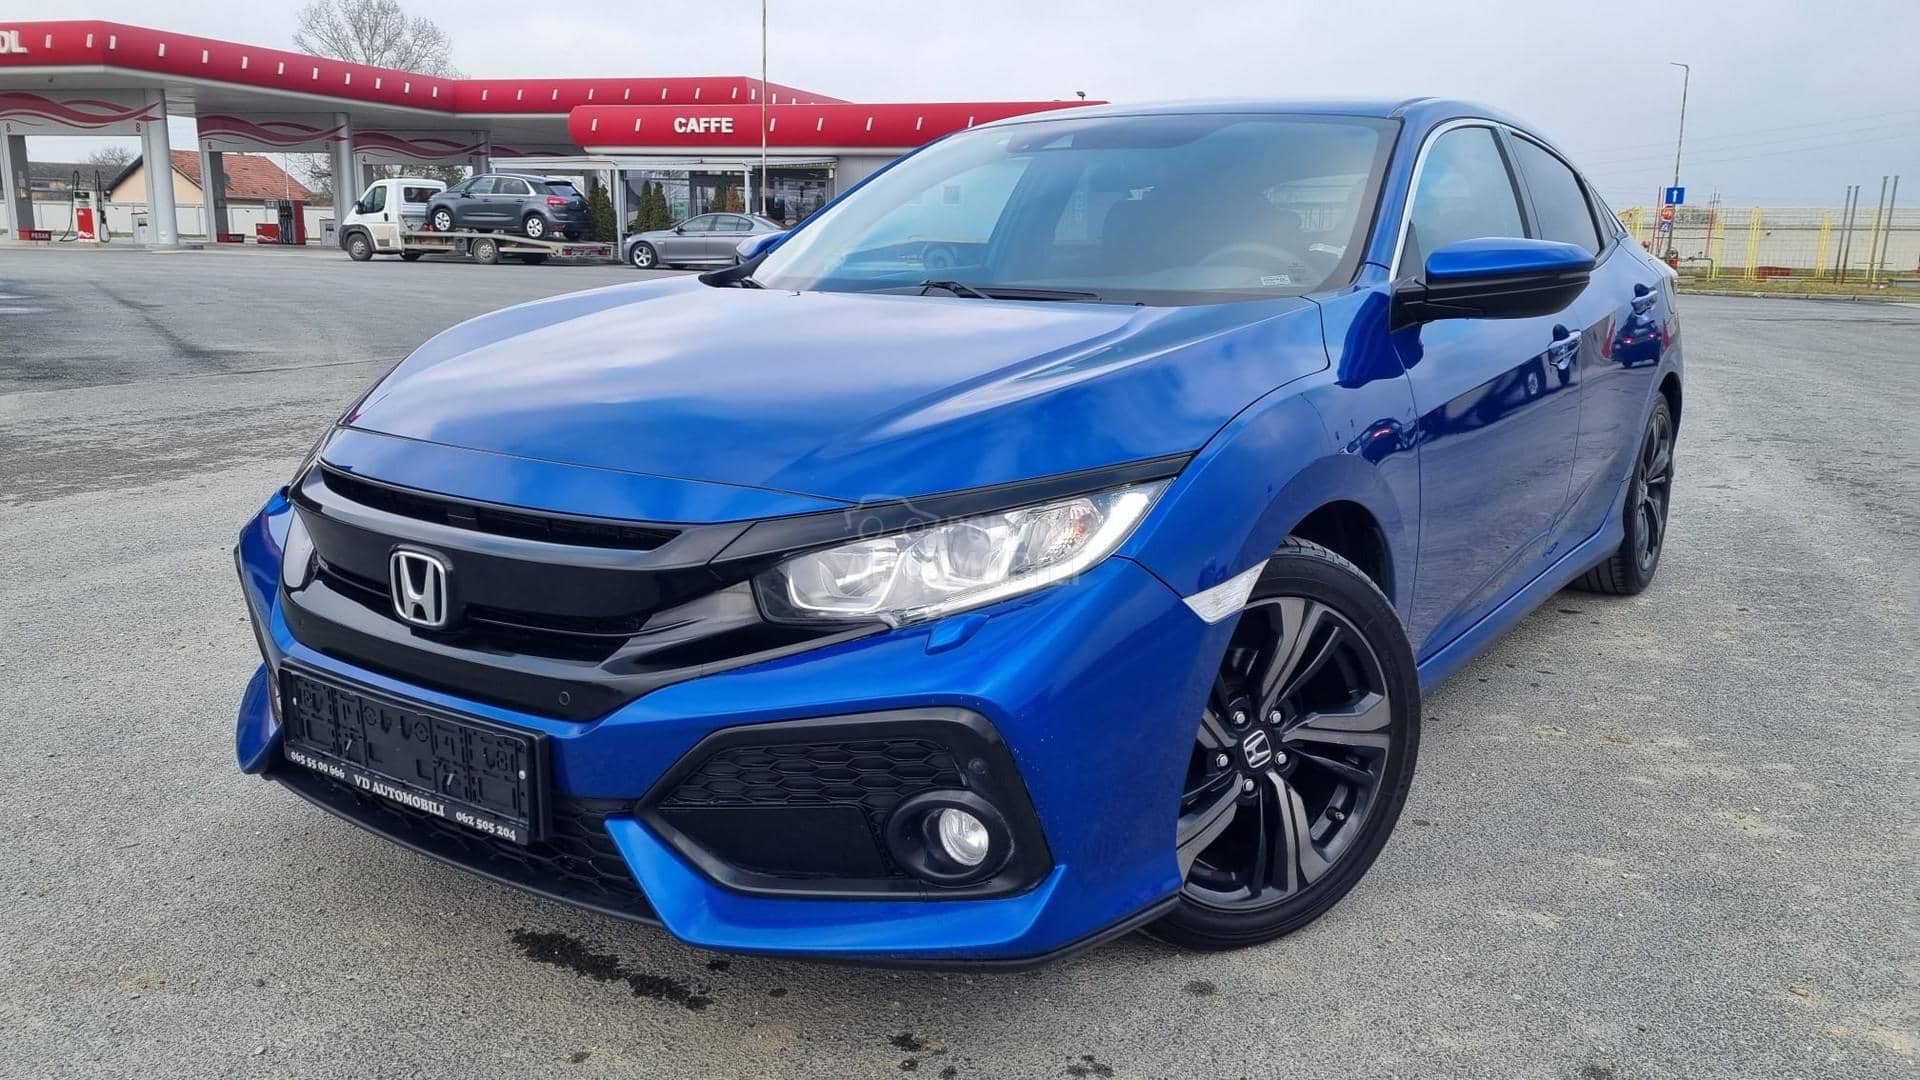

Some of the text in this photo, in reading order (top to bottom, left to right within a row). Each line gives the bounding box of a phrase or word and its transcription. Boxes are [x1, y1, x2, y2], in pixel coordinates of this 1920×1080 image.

[674, 117, 734, 133] CAFFE
[291, 752, 516, 841] 065 55 00 666 VD AUTOMOBILI 062 505 204
